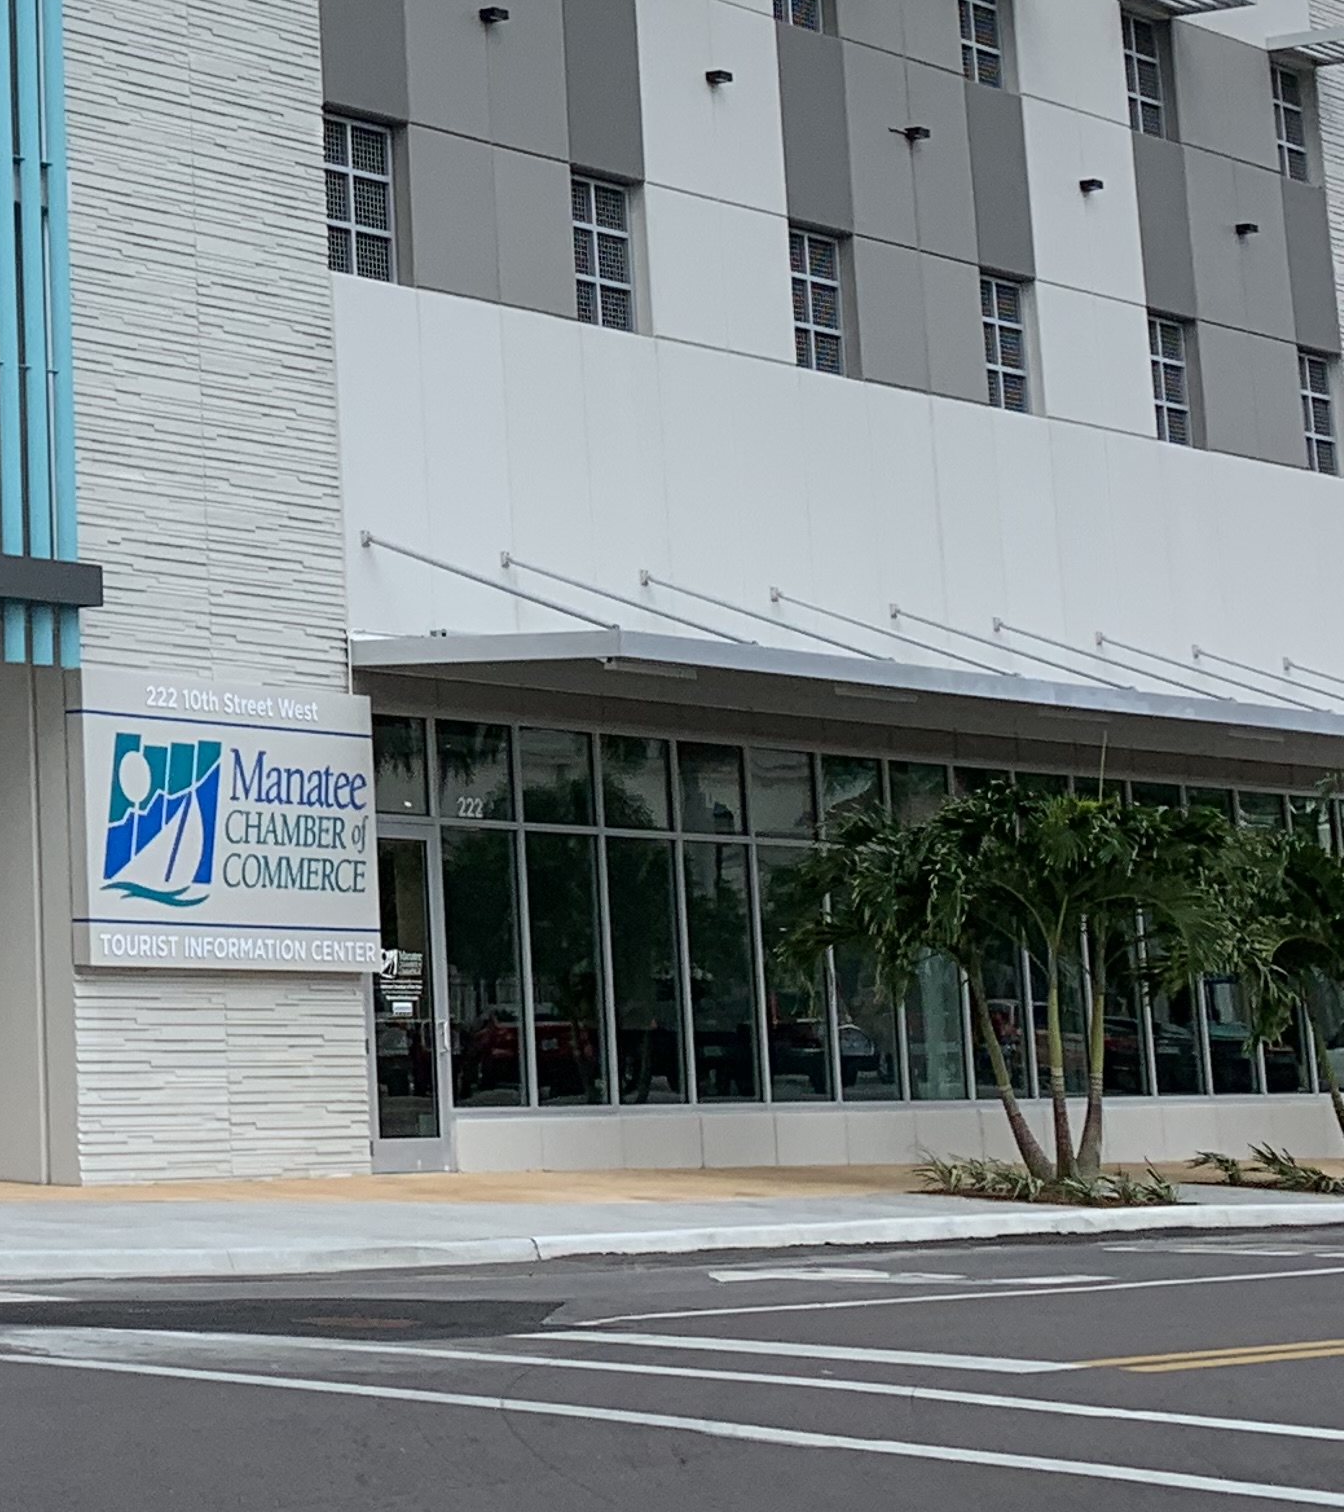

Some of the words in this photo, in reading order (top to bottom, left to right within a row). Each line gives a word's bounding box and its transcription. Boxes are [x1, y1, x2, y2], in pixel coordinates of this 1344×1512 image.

[146, 685, 178, 710] 222
[182, 688, 219, 713] 10th
[223, 692, 274, 718] Street
[277, 697, 319, 722] West
[230, 747, 368, 811] Manatee
[456, 796, 483, 818] 222
[225, 809, 347, 849] CHAMBER
[351, 814, 369, 854] of
[223, 852, 367, 893] COMMERCE
[100, 933, 179, 958] TOURIST
[183, 935, 306, 961] INFORMATION
[310, 939, 377, 963] CENTER
